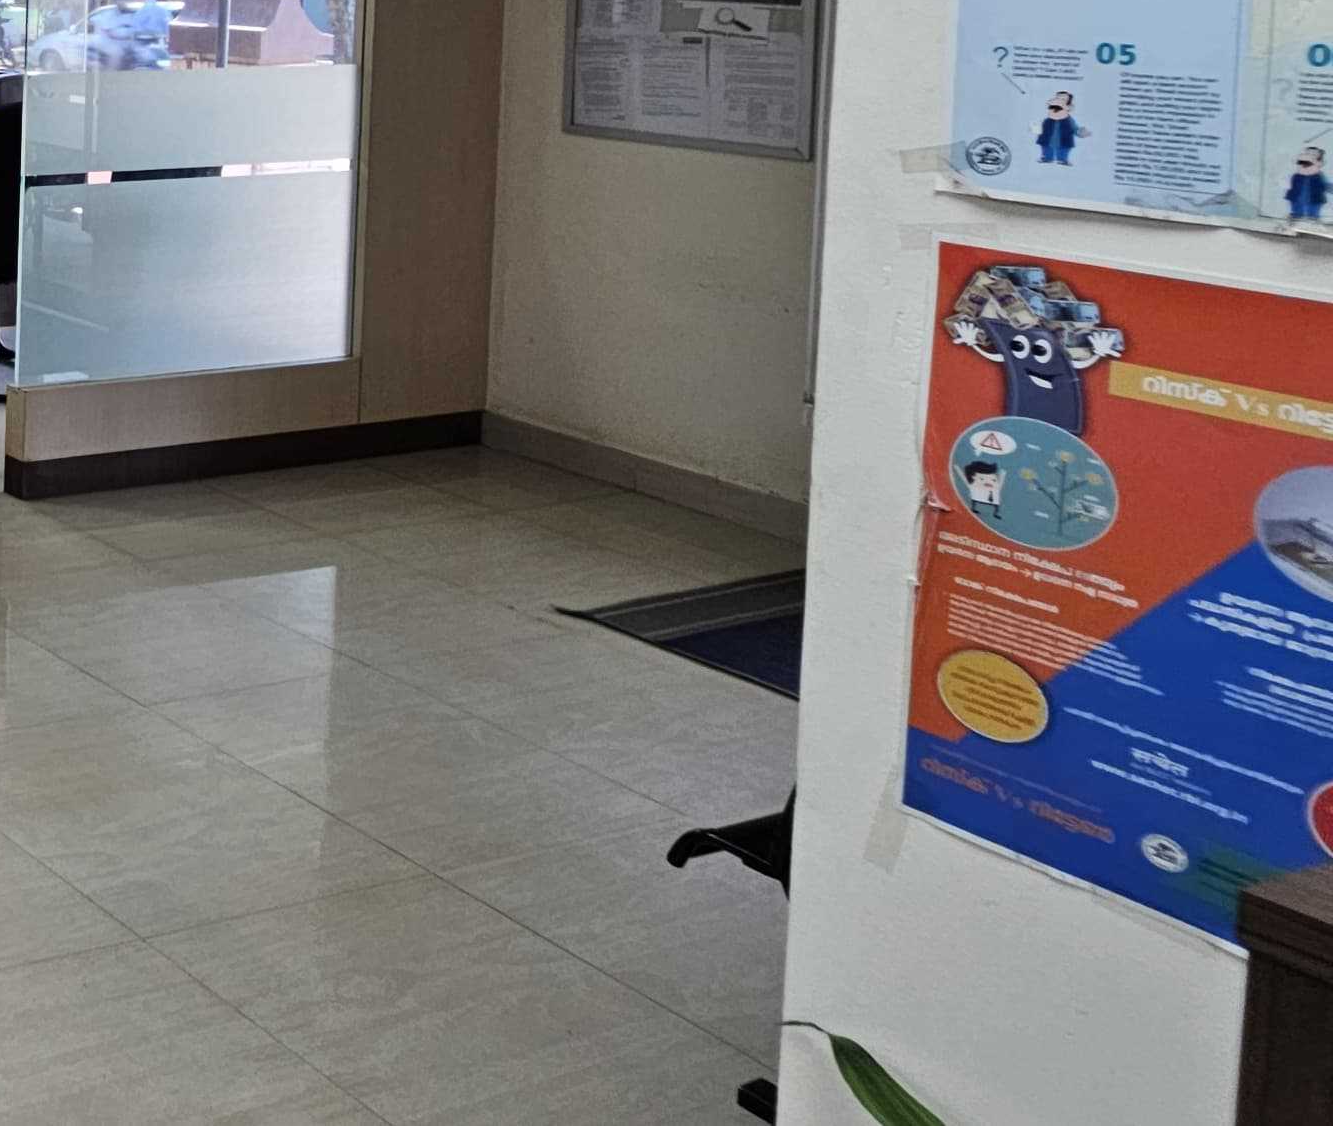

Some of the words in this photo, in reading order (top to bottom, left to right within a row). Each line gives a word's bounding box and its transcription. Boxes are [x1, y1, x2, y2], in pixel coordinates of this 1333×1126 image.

[1095, 42, 1137, 66] 05
[1307, 43, 1333, 67] 0
[1236, 393, 1269, 417] Vs
